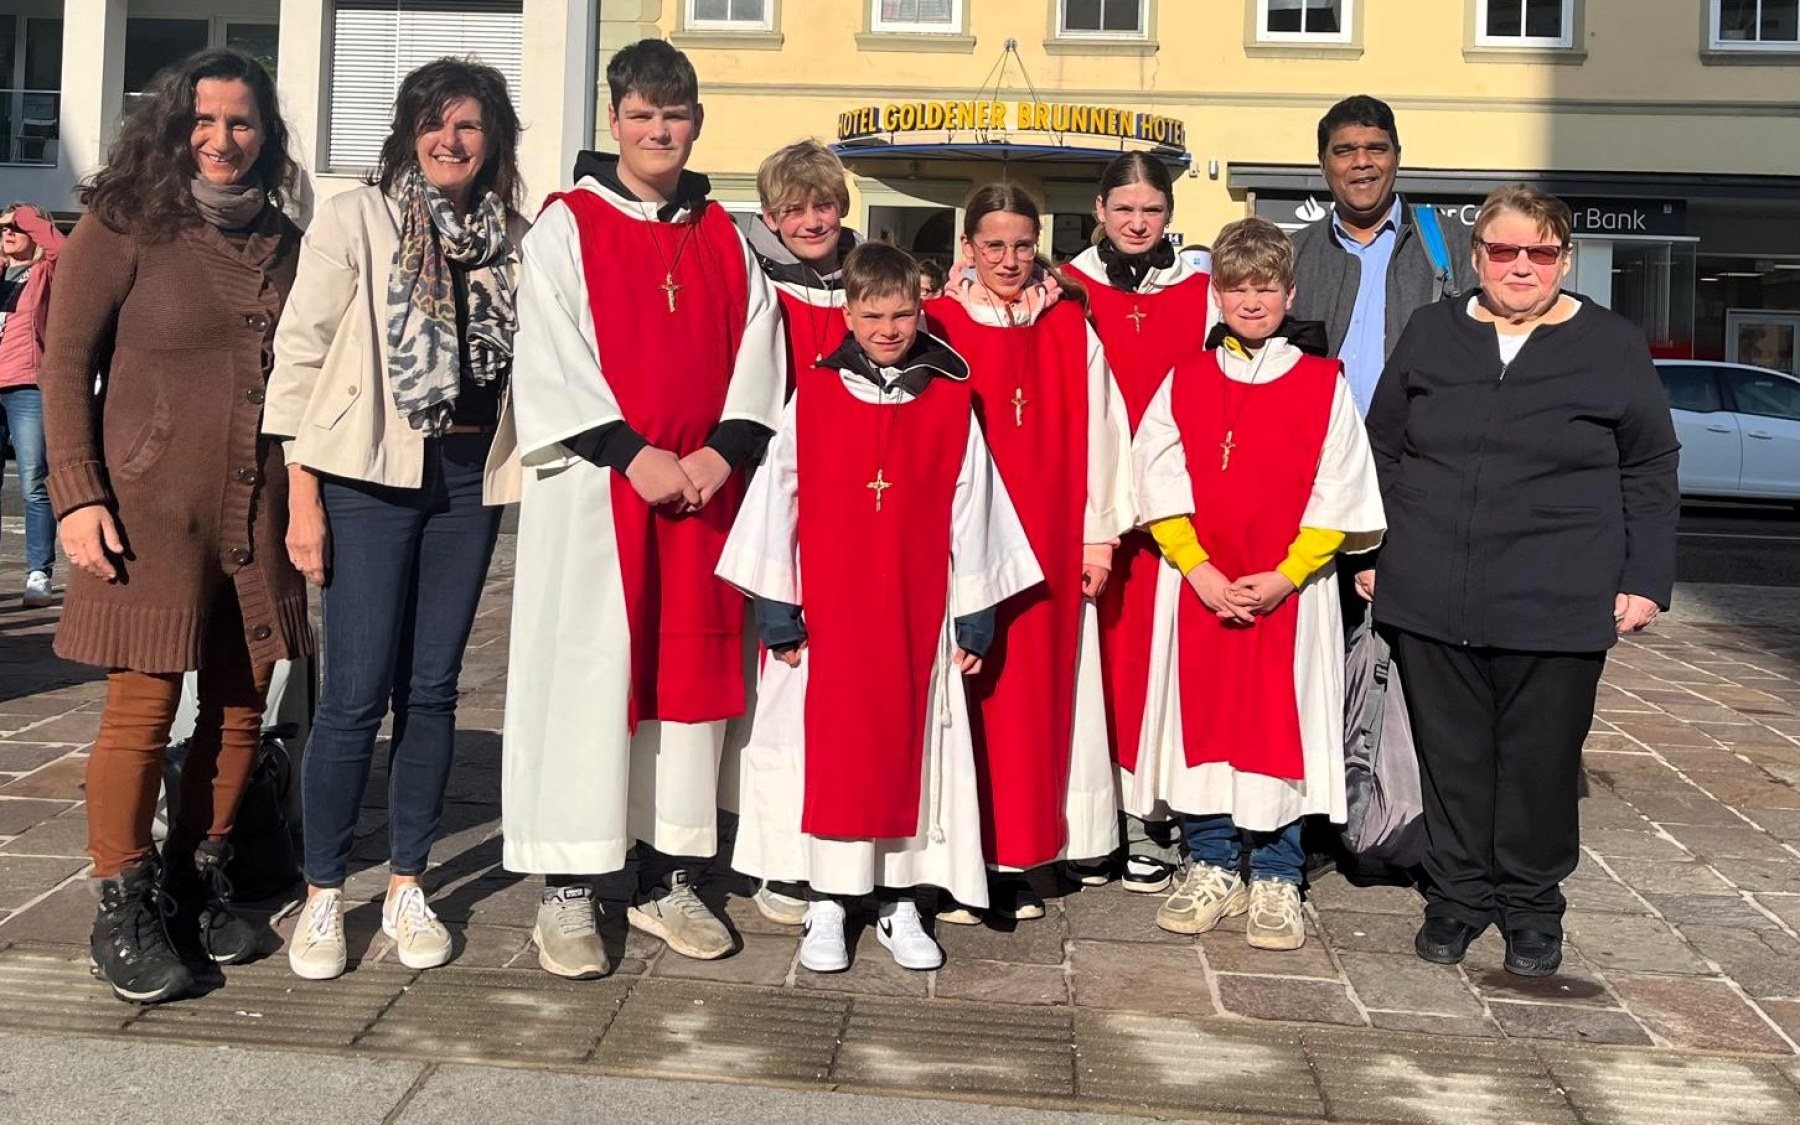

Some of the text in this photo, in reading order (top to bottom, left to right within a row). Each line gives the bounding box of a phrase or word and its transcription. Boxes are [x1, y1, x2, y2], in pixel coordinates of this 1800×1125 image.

[838, 102, 1185, 145] HOTEL GOLDENER BRUNNEN HOTEL
[1587, 207, 1646, 230] Bank
